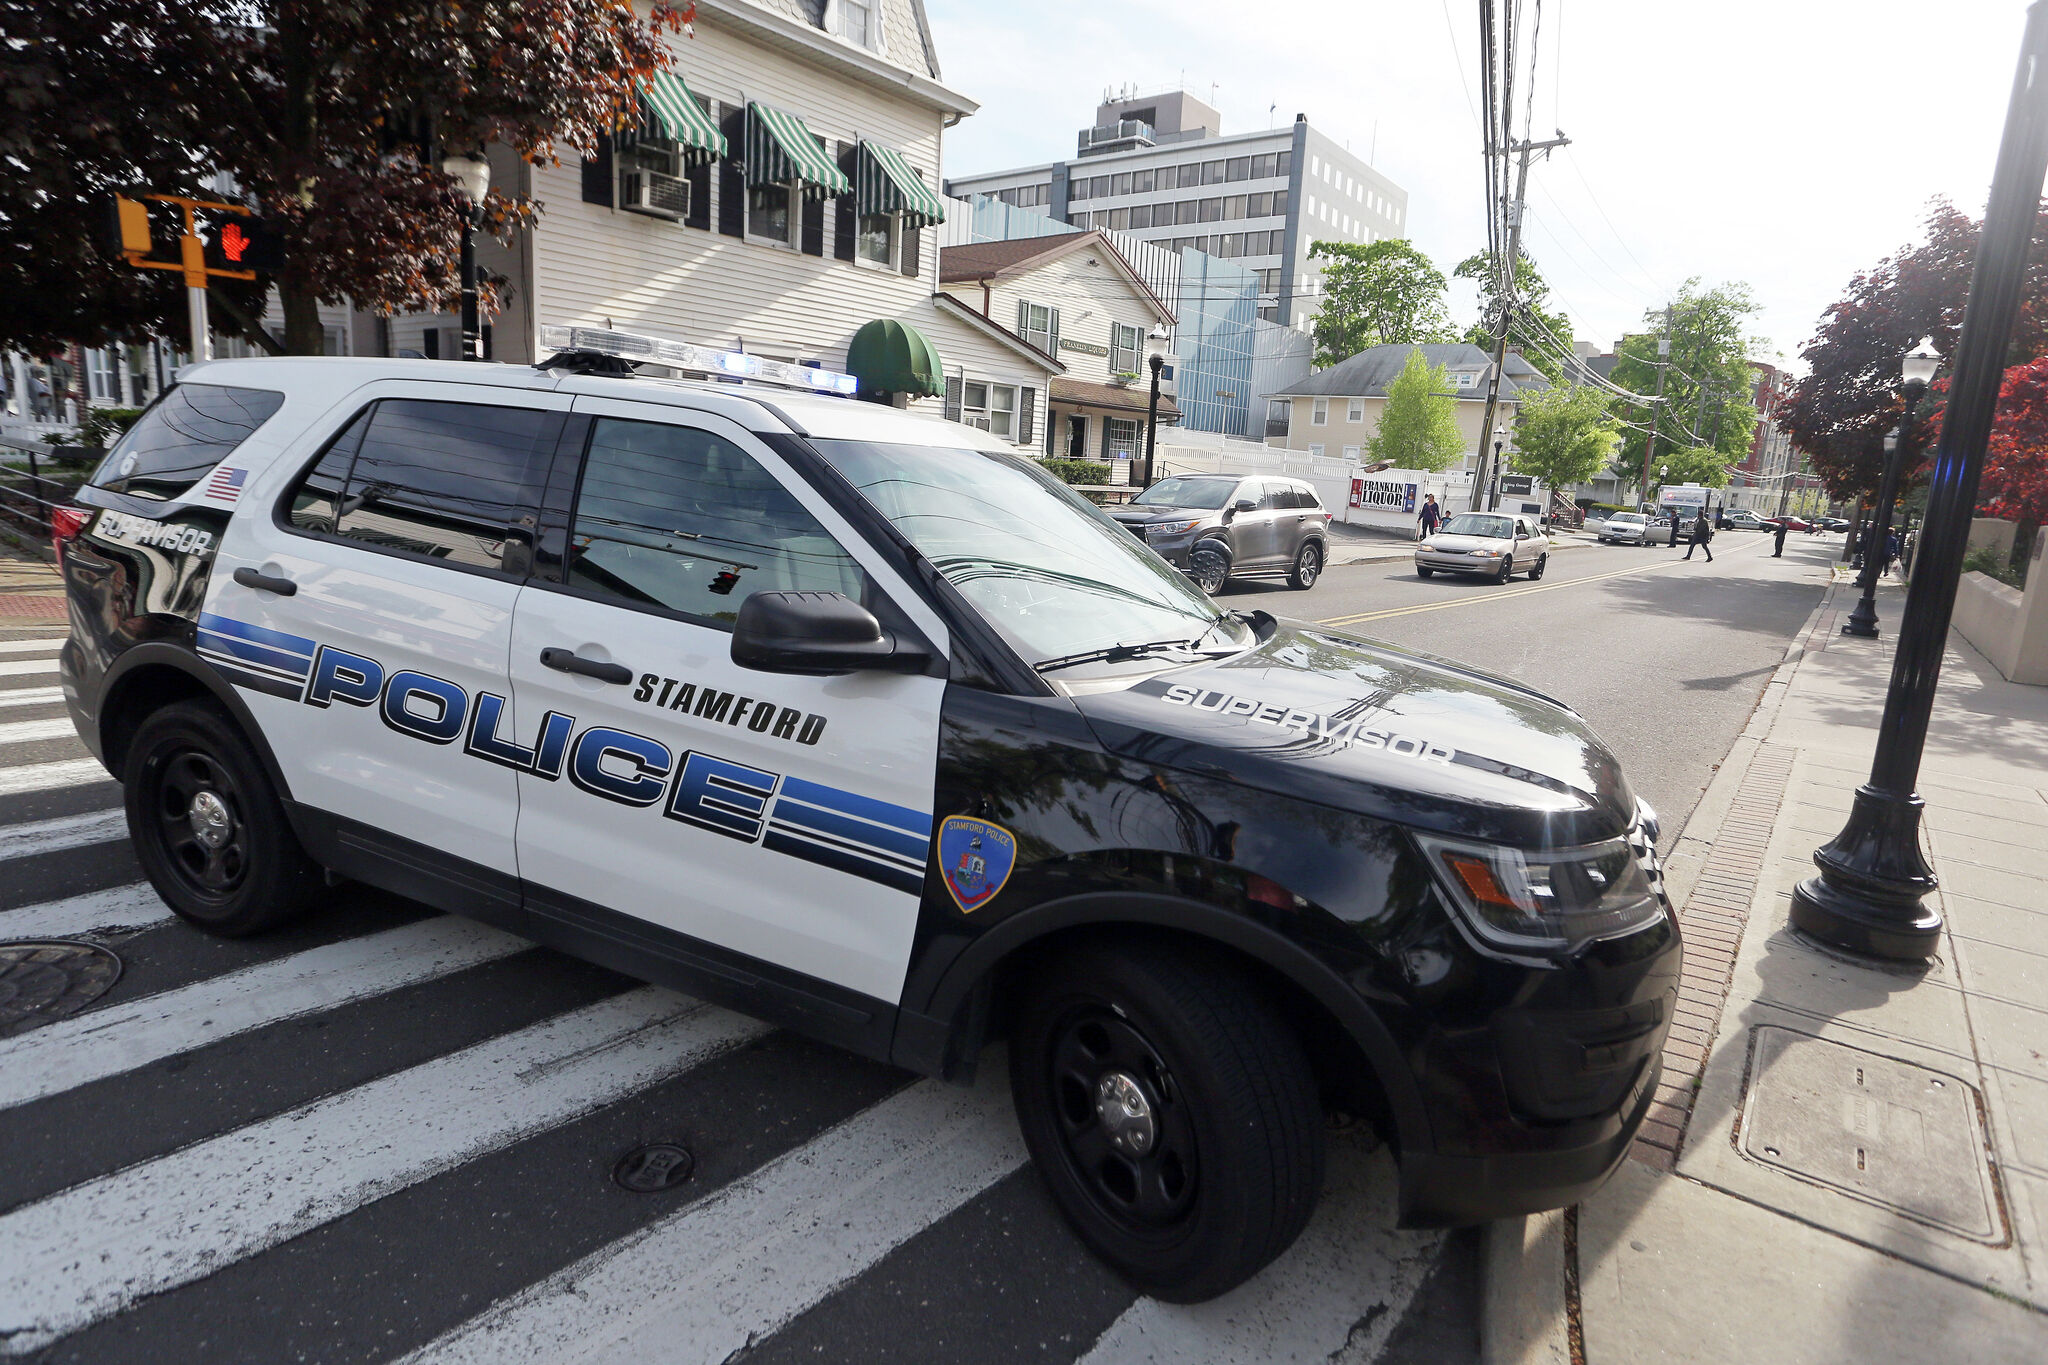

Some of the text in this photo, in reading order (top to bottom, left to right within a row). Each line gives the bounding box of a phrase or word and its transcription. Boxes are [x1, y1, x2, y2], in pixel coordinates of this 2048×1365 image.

[120, 450, 138, 476] 6
[1362, 490, 1403, 506] LIQUOR
[1363, 480, 1404, 493] FRANKLIN
[99, 515, 213, 556] SUPERVISOR
[633, 673, 828, 746] STAMFORD
[1160, 684, 1456, 766] SUPERVISOR
[303, 644, 781, 844] POLICE
[948, 821, 1010, 847] STAMFORD POLICE
